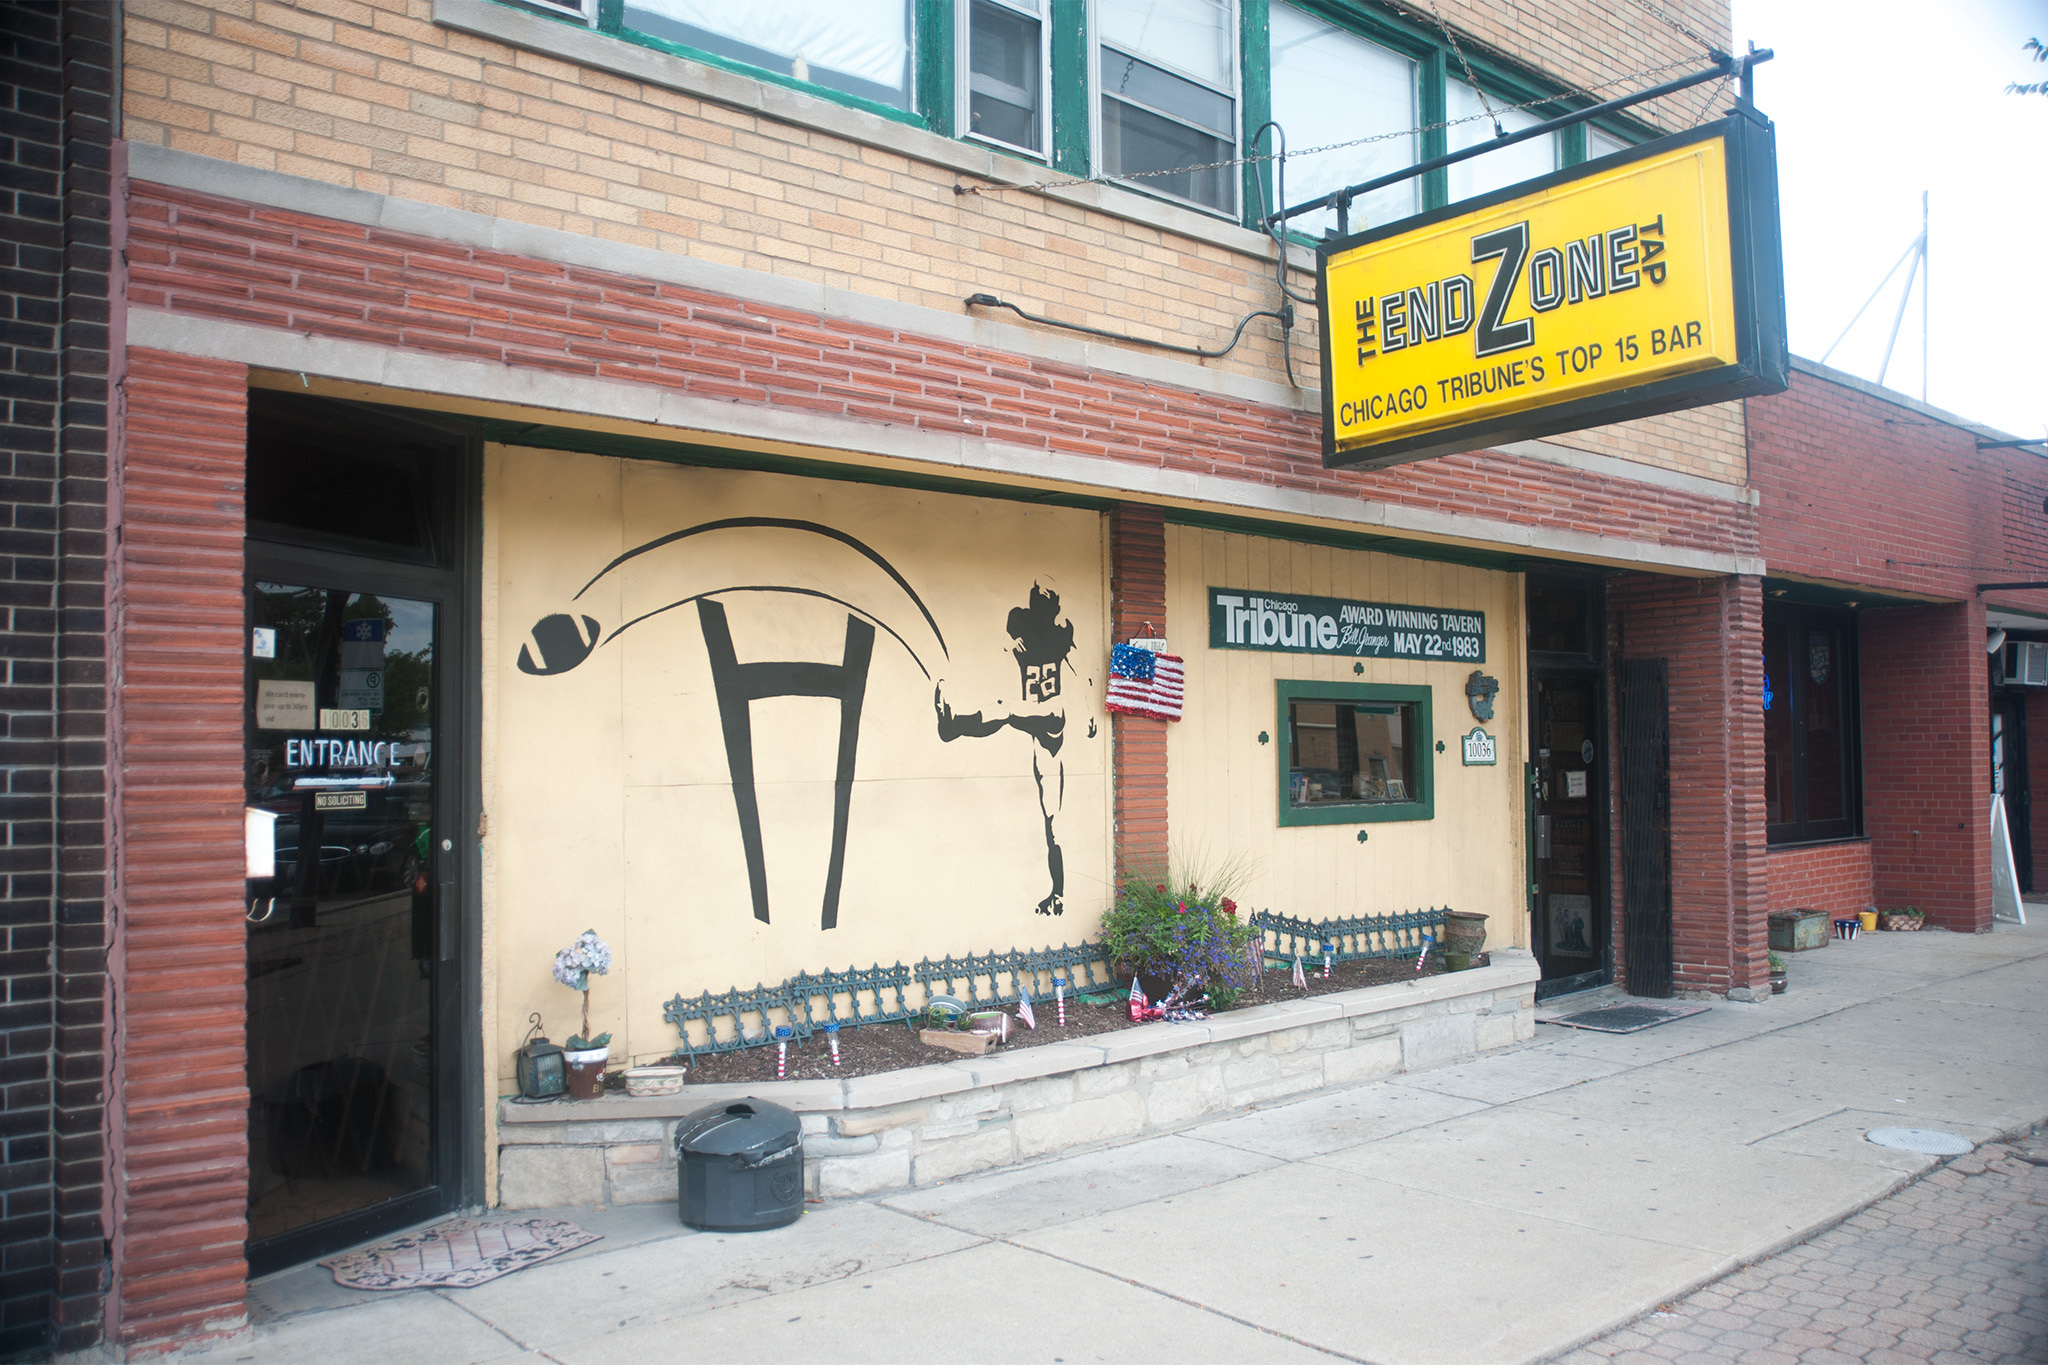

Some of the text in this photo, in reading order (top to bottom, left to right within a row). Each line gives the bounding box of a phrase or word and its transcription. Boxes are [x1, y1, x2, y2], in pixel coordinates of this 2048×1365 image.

[1640, 214, 1667, 285] TAP
[1356, 296, 1376, 366] THE
[1340, 320, 1703, 428] CHICAGO TRIBUNE'S TOP 15 BAR
[1264, 599, 1298, 615] Chicago
[1339, 605, 1482, 634] AWARD WINNING TAVERN
[1217, 594, 1338, 650] Tribune
[1336, 624, 1358, 649] Bill
[1393, 632, 1423, 655] MAY
[1452, 636, 1479, 658] 1983
[1026, 662, 1057, 702] 26
[323, 711, 368, 728] 10036
[287, 739, 400, 766] ENTRANCE
[1468, 742, 1491, 757] 10036
[317, 794, 364, 806] NO SOLICITING
